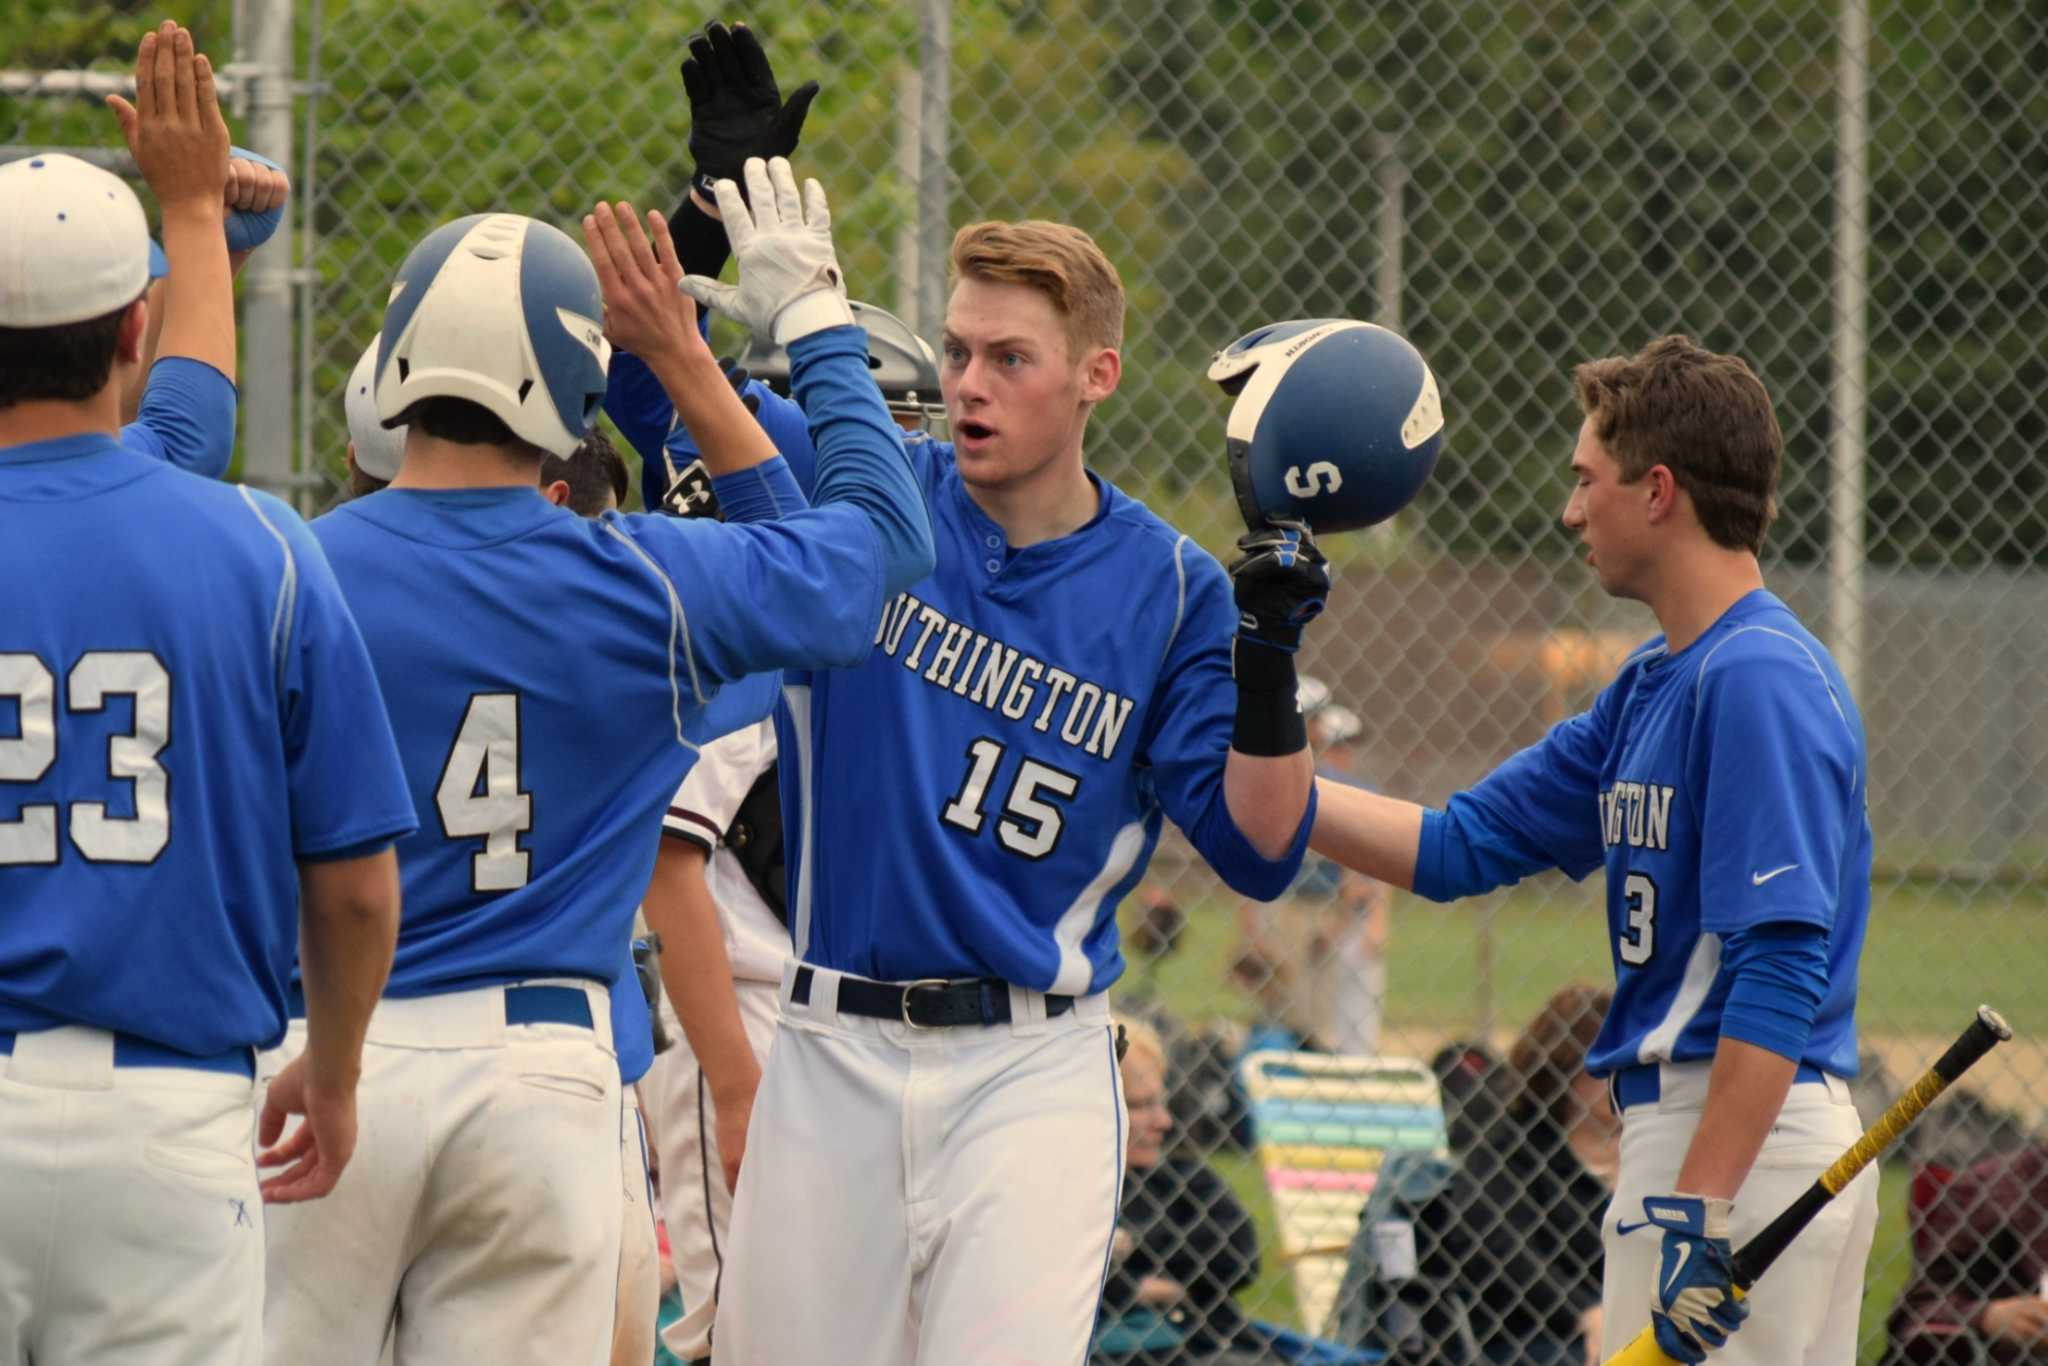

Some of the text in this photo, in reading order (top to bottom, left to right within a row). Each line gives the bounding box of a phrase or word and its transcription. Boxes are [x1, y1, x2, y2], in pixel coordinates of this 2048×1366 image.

[1284, 461, 1343, 498] S
[0, 651, 170, 866] 23
[436, 693, 532, 891] 4
[940, 736, 1081, 860] 15
[1619, 872, 1657, 966] 3
